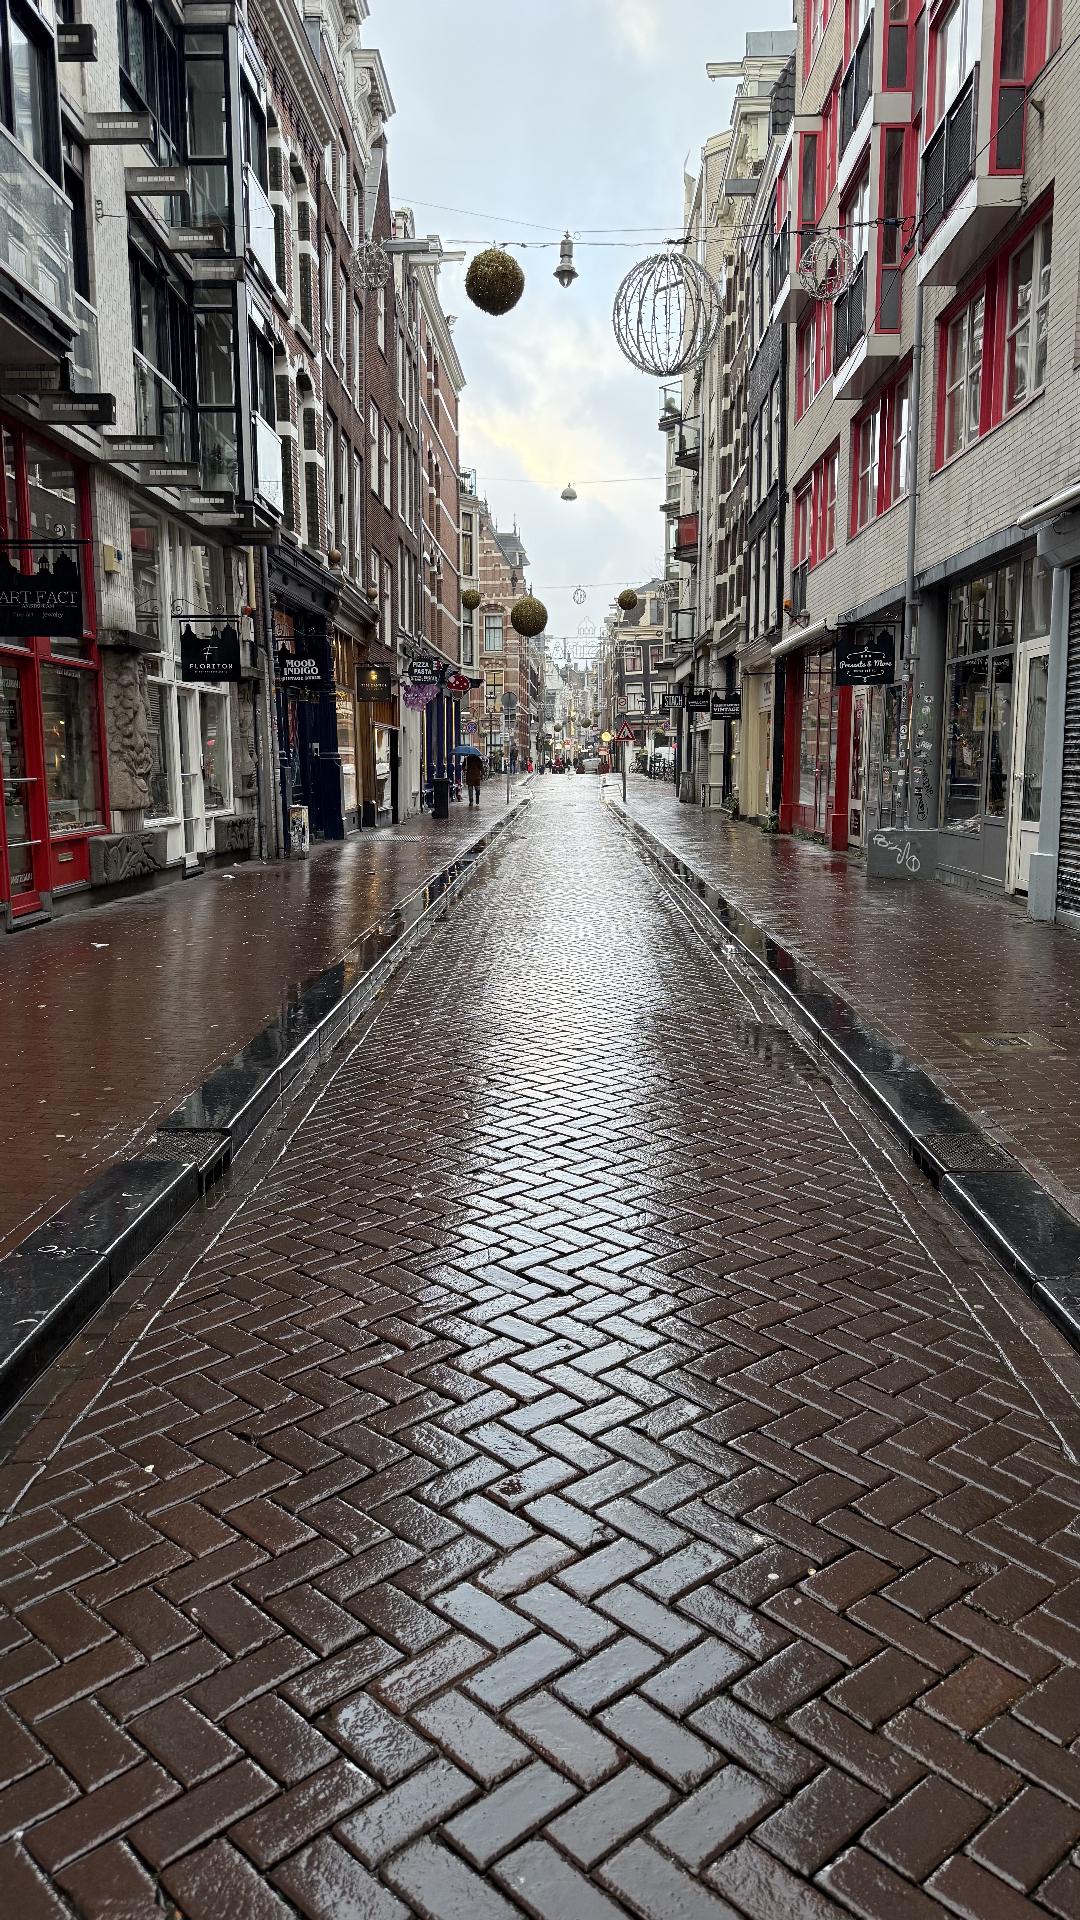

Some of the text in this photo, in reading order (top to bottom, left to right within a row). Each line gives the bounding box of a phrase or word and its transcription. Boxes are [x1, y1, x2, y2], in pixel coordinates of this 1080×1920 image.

[0, 591, 78, 603] ART FACT
[285, 659, 316, 668] MOOD
[839, 660, 867, 669] Presents
[873, 659, 893, 667] More
[283, 667, 319, 675] INDIGO
[664, 695, 683, 706] STACH
